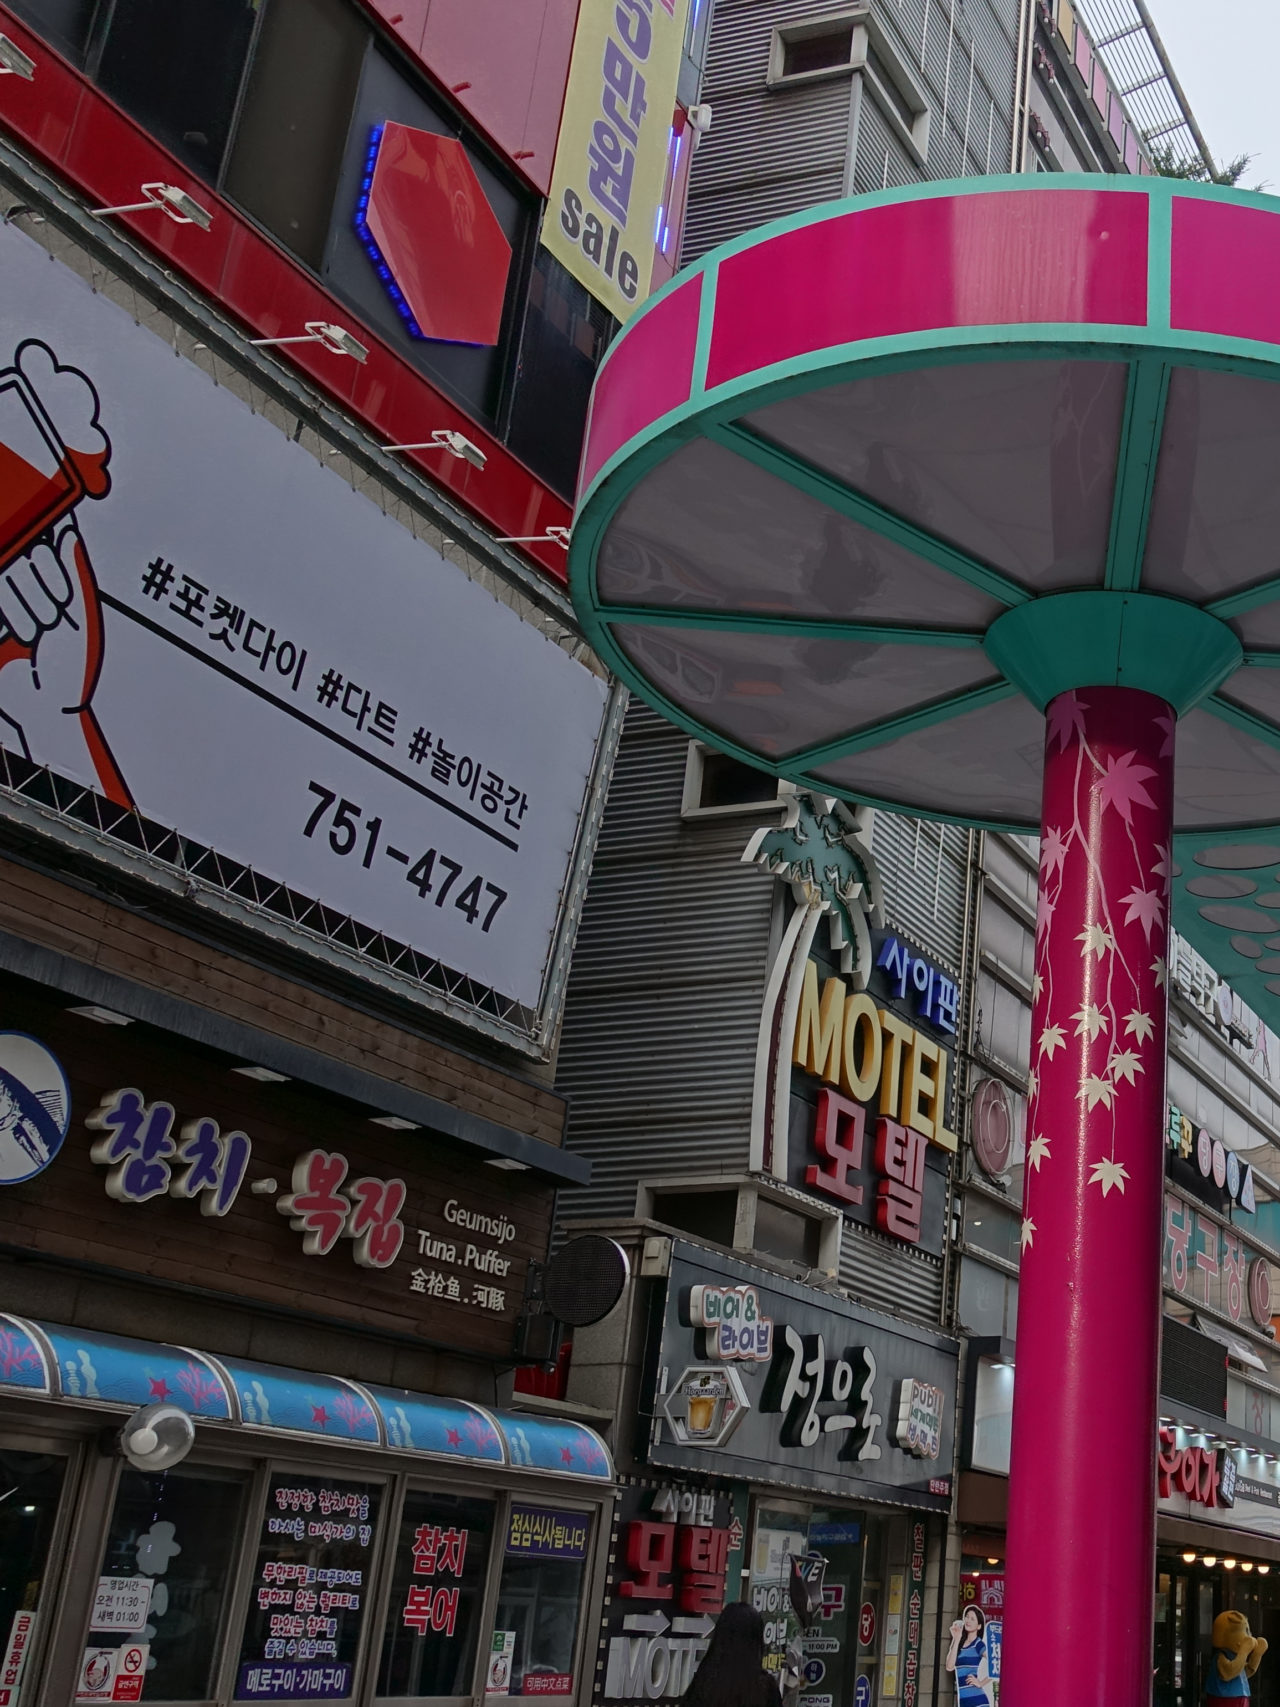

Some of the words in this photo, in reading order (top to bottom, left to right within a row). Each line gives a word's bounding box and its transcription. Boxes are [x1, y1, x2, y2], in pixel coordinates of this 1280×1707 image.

[560, 187, 639, 300] sale
[141, 557, 307, 691] #포켓다이
[316, 668, 398, 746] #다트
[407, 727, 529, 830] #놀이공간
[302, 780, 509, 933] 751-4747
[877, 936, 959, 1035] 사이판
[792, 958, 959, 1154] MOTEL
[805, 1086, 929, 1243] 모텔
[443, 1199, 516, 1244] Geumsijo
[1166, 1192, 1246, 1322] 당구장
[705, 1292, 740, 1320] 비어
[744, 1293, 757, 1322] &
[721, 1323, 770, 1354] 라이브
[275, 1488, 316, 1512] 진정한
[318, 1490, 370, 1520] 참치맛을
[652, 1490, 717, 1527] 사이판
[268, 1518, 305, 1541] 아시는
[308, 1521, 357, 1543] 미식가의
[358, 1525, 371, 1547] 집
[411, 1523, 469, 1578] 참치
[510, 1513, 587, 1551] 점심식사됩니다
[110, 1580, 139, 1592] 영업시간
[262, 1562, 317, 1587] 무한리필로
[317, 1567, 362, 1588] 제공되어도
[620, 1520, 731, 1615] 모텔
[96, 1595, 114, 1607] 오전
[115, 1596, 139, 1607] 11:30
[97, 1610, 115, 1622] 새벽
[115, 1611, 140, 1623] 01:00
[257, 1588, 293, 1610] 변하지
[294, 1589, 318, 1613] 않는
[319, 1590, 359, 1614] 퀄리티로
[403, 1584, 460, 1637] 복어
[269, 1615, 305, 1637] 맛있는
[306, 1616, 337, 1638] 참치를
[265, 1638, 285, 1659] 즐길
[286, 1639, 297, 1658] 수
[826, 1643, 838, 1652] PM
[526, 1676, 572, 1691] 可用中文点菜
[604, 1635, 712, 1700] MOTE
